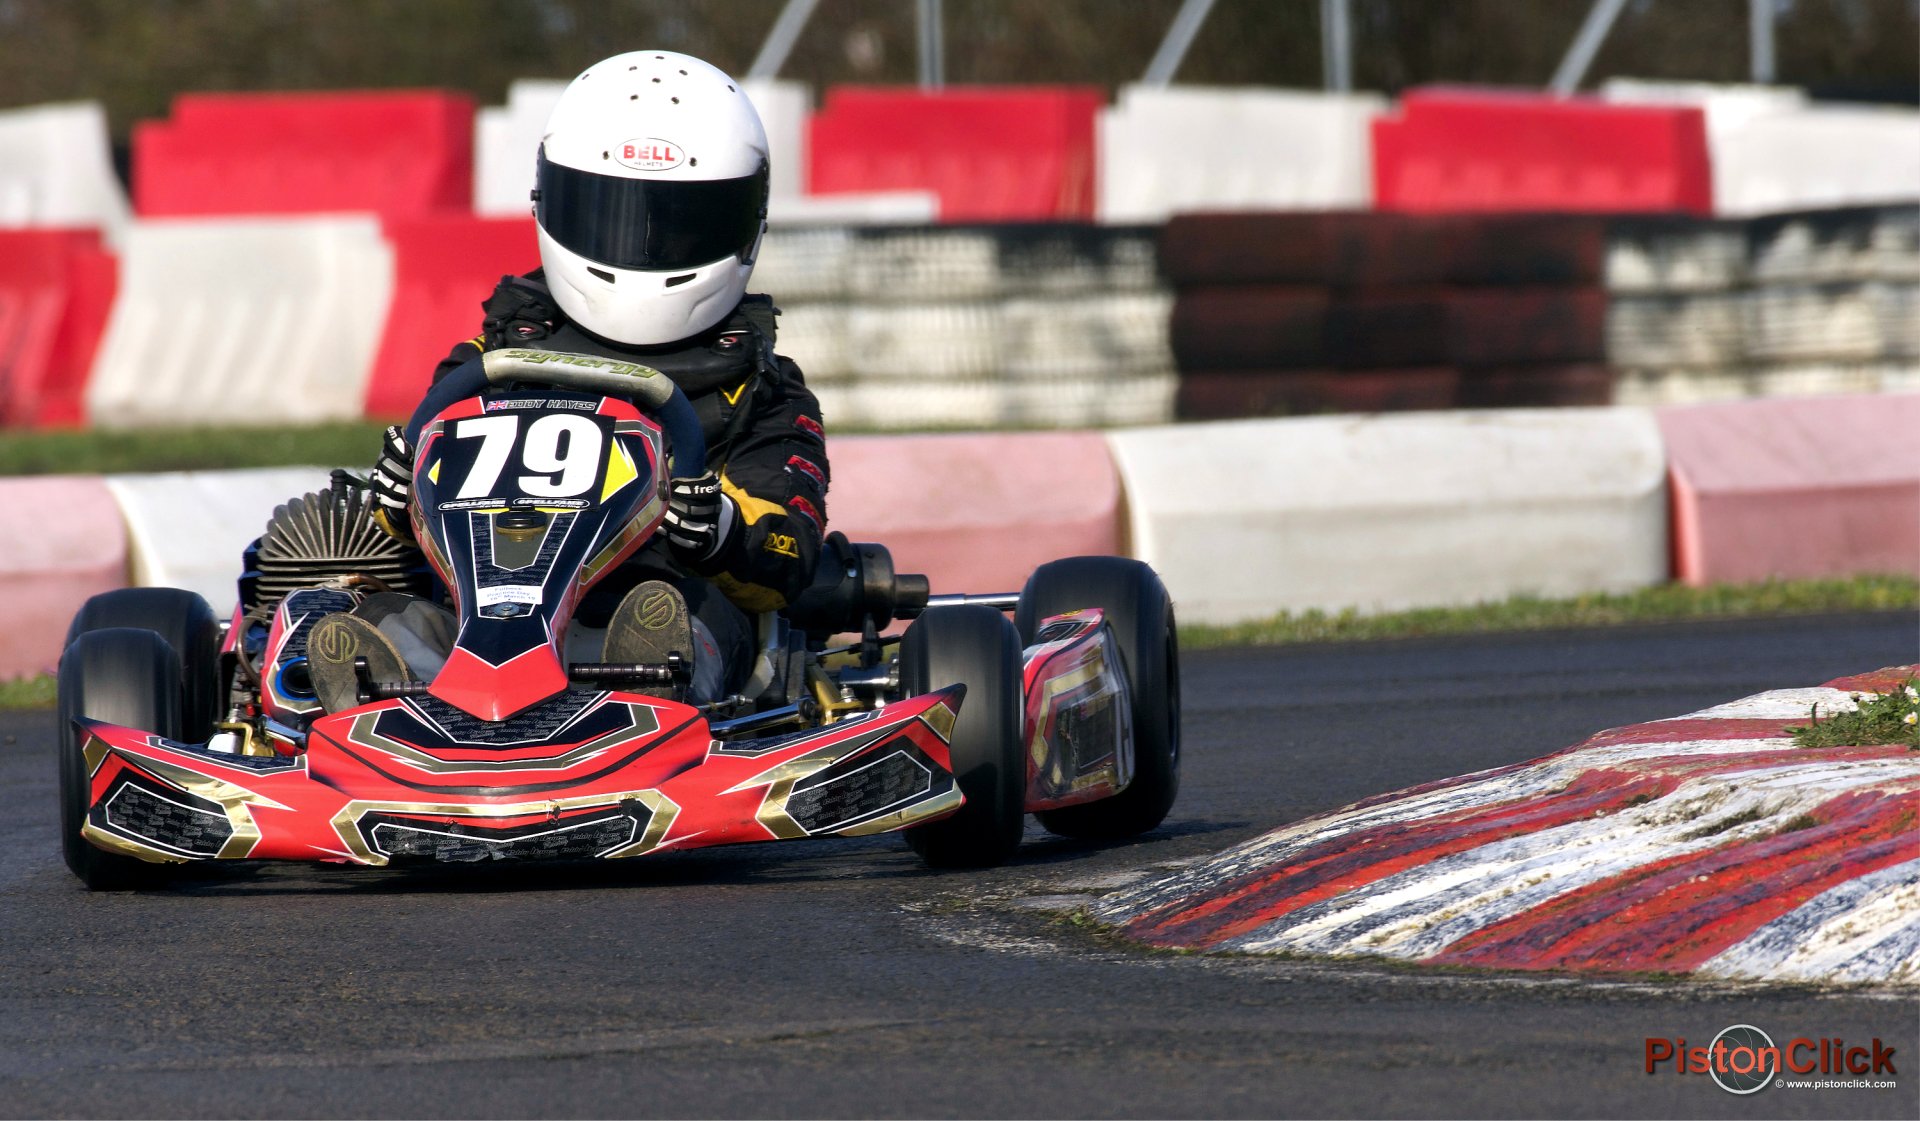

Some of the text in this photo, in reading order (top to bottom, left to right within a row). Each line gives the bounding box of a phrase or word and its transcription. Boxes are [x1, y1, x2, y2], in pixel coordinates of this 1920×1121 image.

[623, 144, 675, 161] BELL
[506, 399, 597, 411] EDDY HAYES
[455, 413, 603, 500] 79
